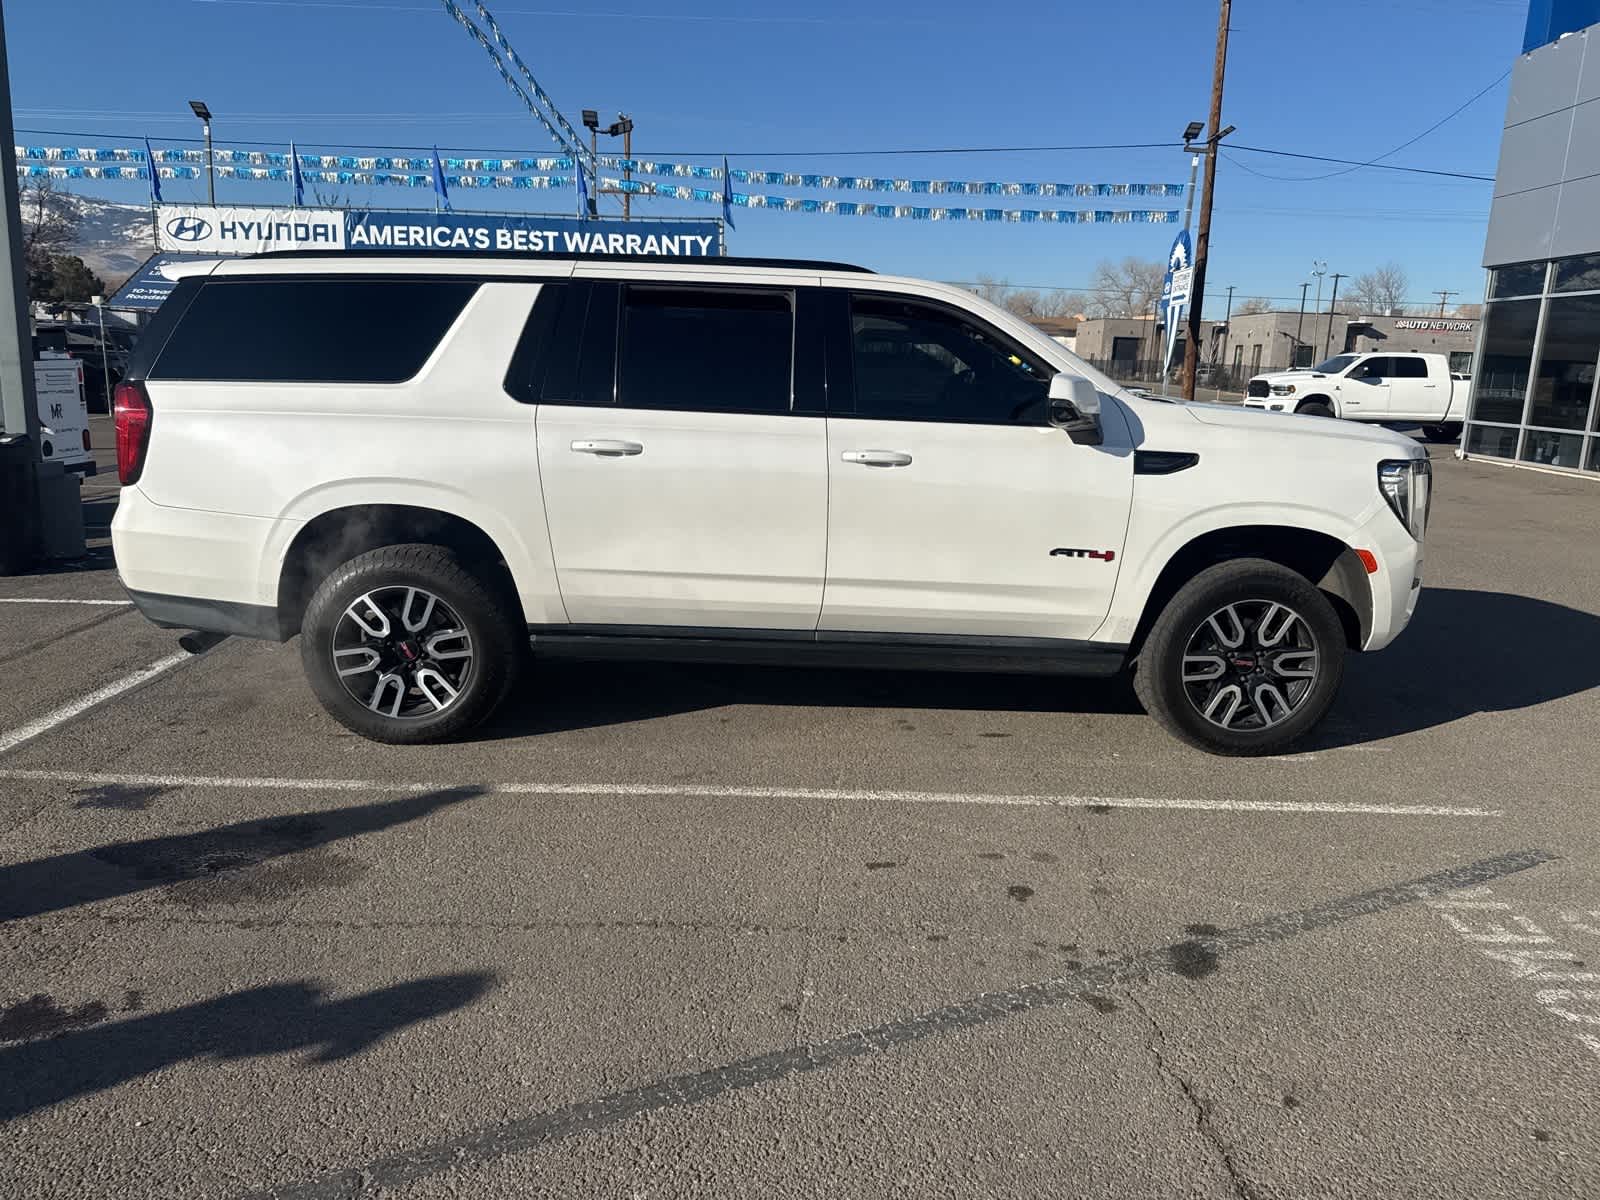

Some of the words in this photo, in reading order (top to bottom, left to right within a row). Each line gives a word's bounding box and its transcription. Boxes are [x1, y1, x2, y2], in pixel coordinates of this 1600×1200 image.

[219, 220, 338, 243] HYUNDAI
[351, 224, 490, 249] AMERICA'S
[496, 229, 559, 252] BEST
[563, 231, 713, 256] WARRANTY
[1429, 321, 1472, 331] NETWORK
